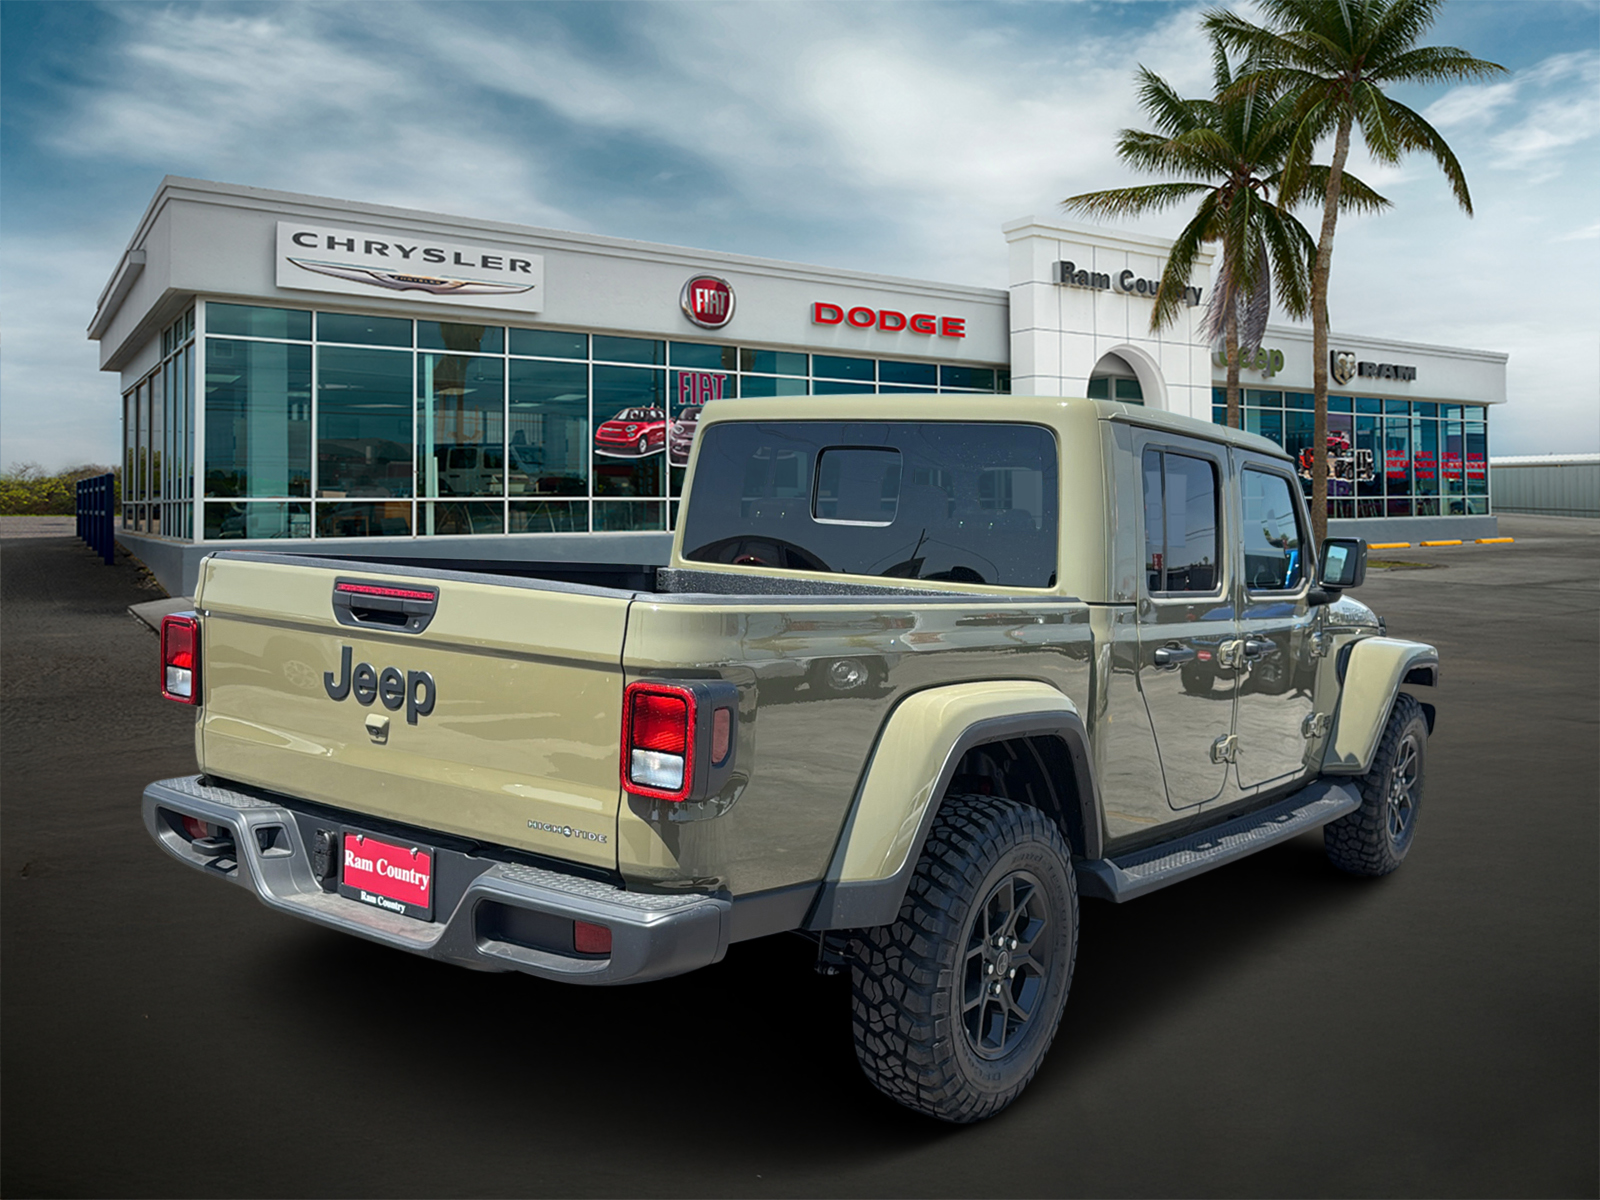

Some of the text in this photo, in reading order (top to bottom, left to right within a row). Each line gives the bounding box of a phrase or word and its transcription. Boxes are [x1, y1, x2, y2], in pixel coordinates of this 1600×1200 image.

[292, 232, 532, 273] CHRYSLER
[1055, 260, 1110, 290] Ram
[695, 287, 728, 316] FIAT
[812, 301, 966, 338] DODGE
[1358, 361, 1417, 381] RAM
[678, 371, 727, 405] FIAT
[324, 646, 436, 725] Jeep
[527, 819, 607, 843] HIGH TIDE
[344, 849, 430, 891] Ram Country
[360, 891, 406, 914] Ram Country
